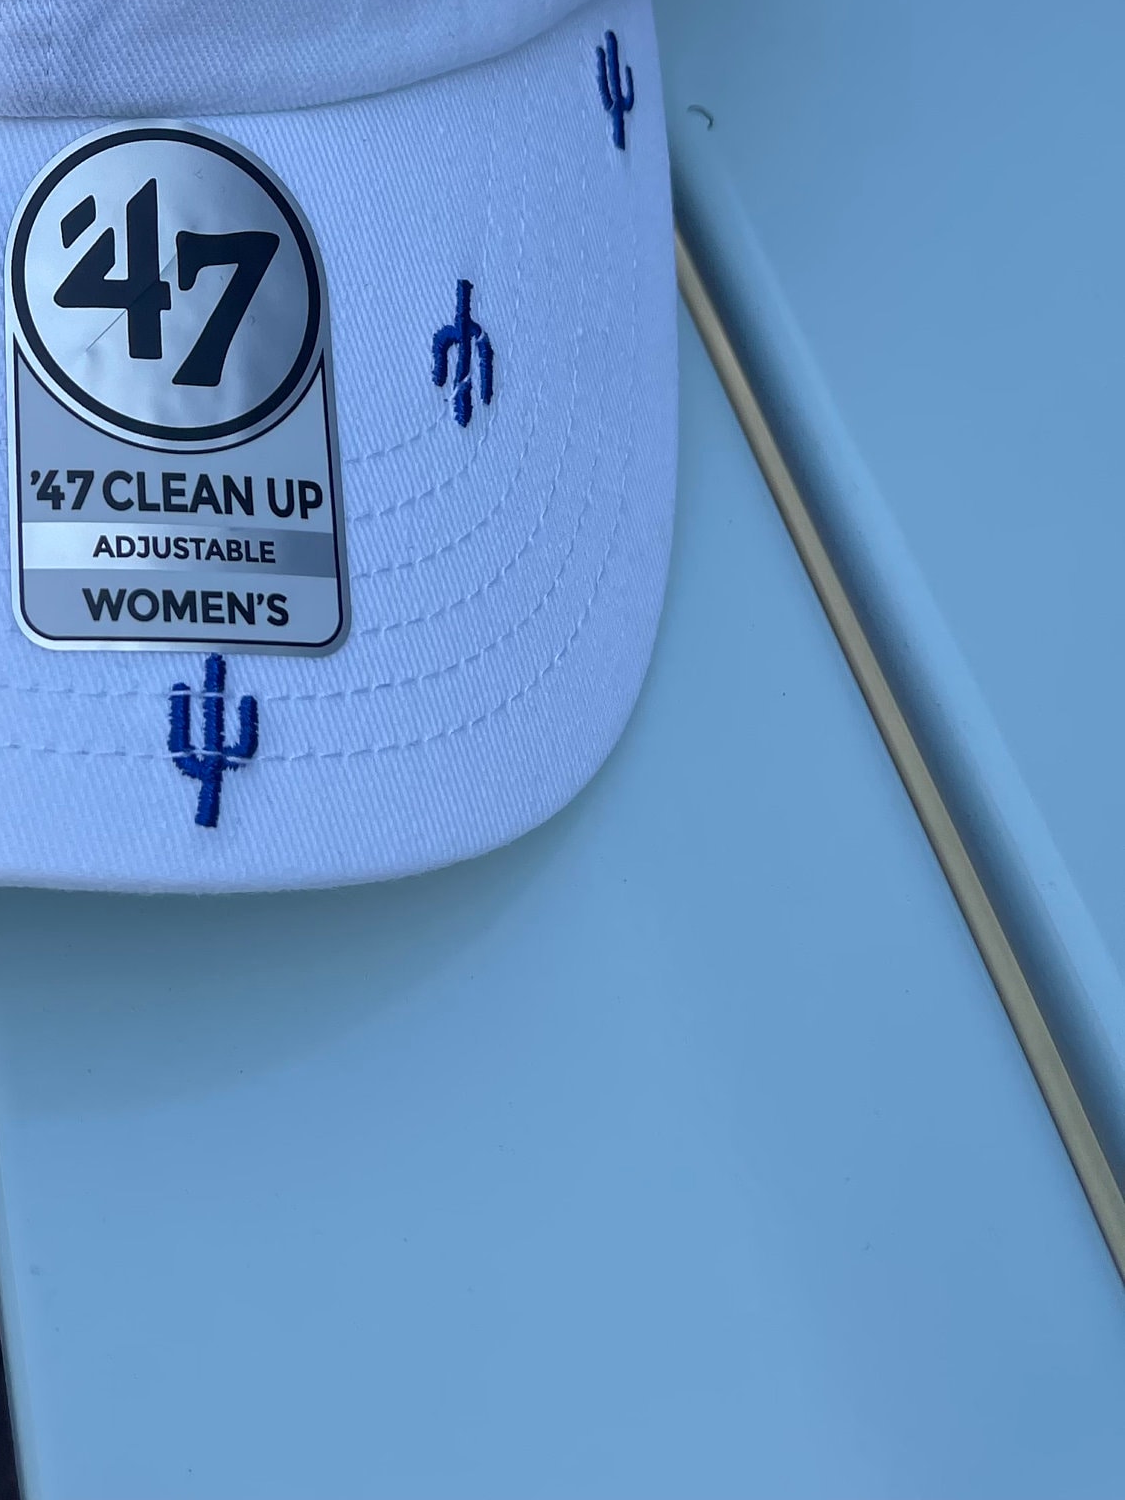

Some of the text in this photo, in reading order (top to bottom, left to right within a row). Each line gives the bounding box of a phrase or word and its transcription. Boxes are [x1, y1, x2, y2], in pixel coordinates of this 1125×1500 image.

[29, 469, 324, 520] '47 CLEAN UP
[92, 534, 276, 564] ADJUSTABLE
[82, 587, 290, 627] WOMEN'S
